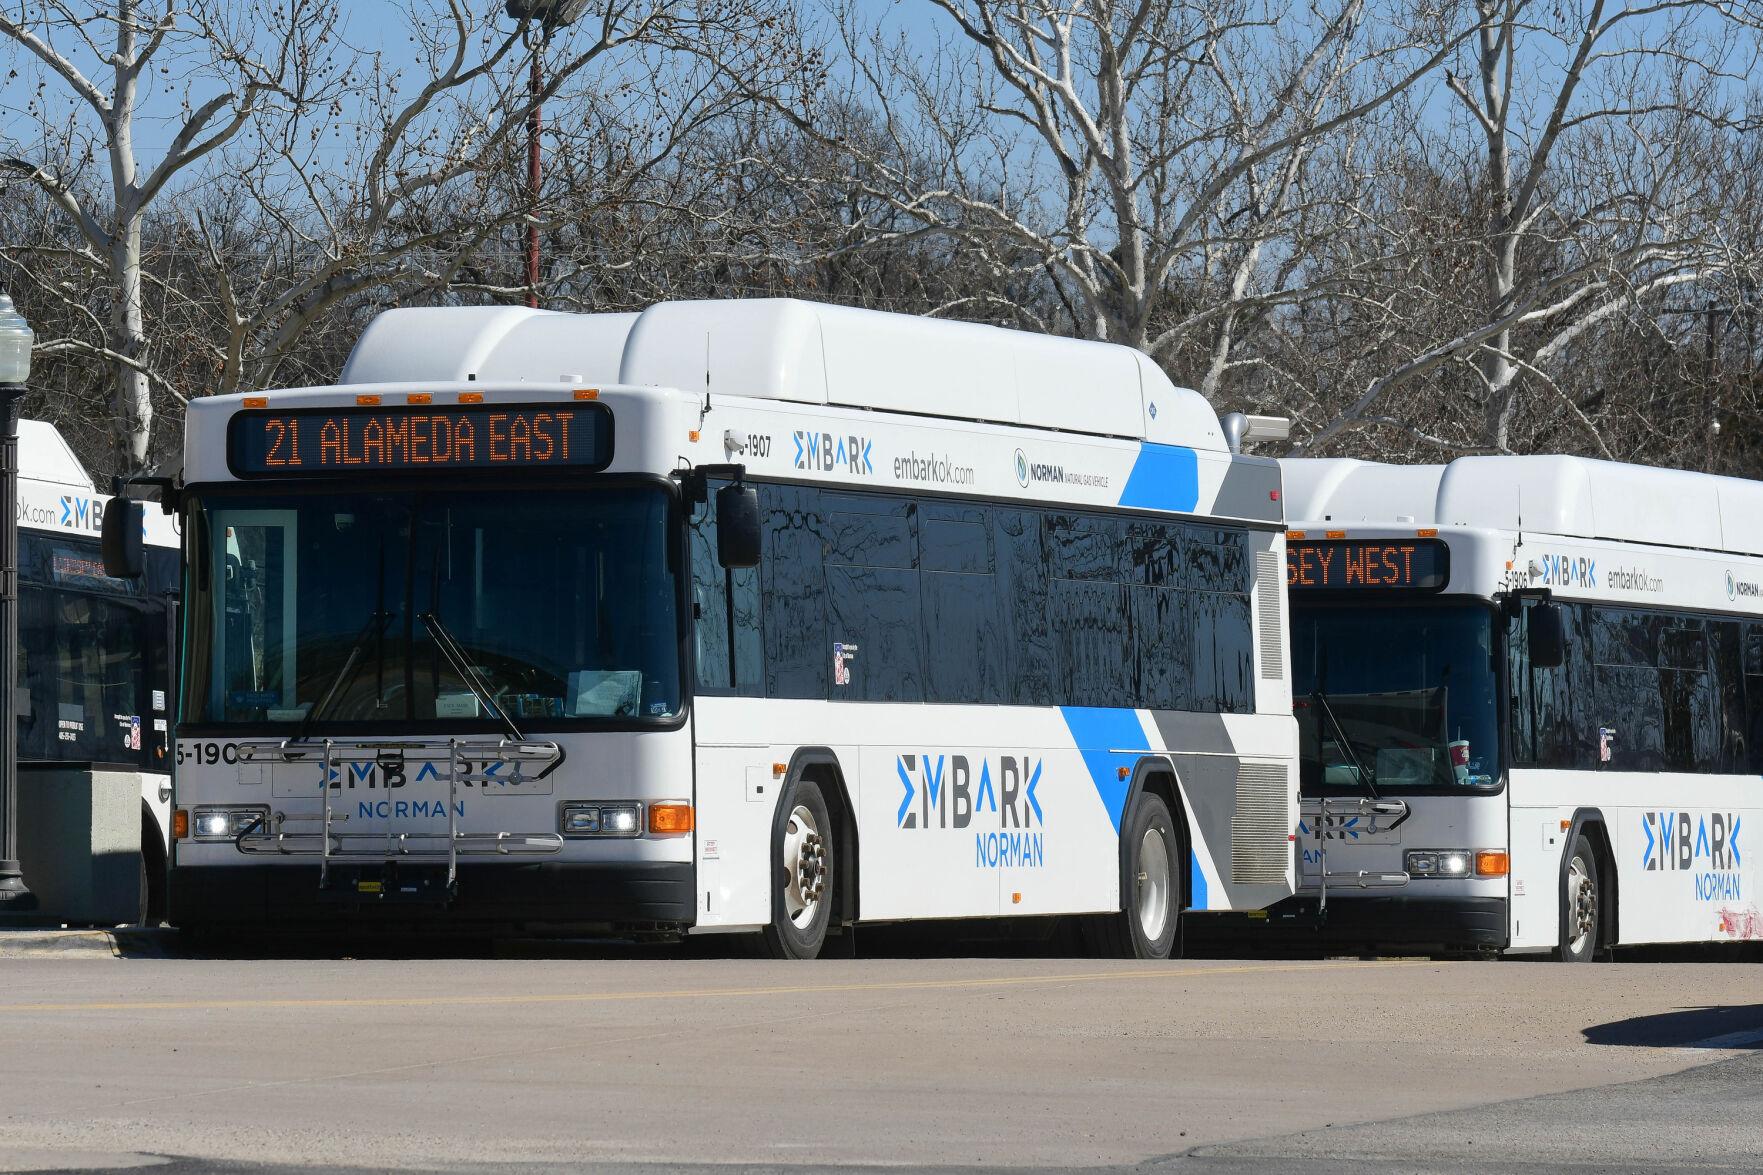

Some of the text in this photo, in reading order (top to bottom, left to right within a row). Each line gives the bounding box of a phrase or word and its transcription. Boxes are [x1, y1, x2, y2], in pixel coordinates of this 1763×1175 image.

[265, 412, 575, 466] 21 ALAMEDA EAST
[793, 430, 873, 475] EMBARK
[894, 450, 975, 486] embarkok.com
[1030, 463, 1064, 483] NORMAN
[1287, 546, 1415, 585] SEY WEST
[1542, 554, 1596, 589] EMBARK
[1608, 566, 1664, 593] embarkok.com
[1736, 581, 1759, 597] NORMAN
[359, 800, 464, 819] NORMAN
[896, 754, 1043, 829] EMBARK
[976, 832, 1043, 868] NORMAN
[1643, 812, 1741, 871] EMBARK
[1695, 873, 1741, 901] NORMAN
